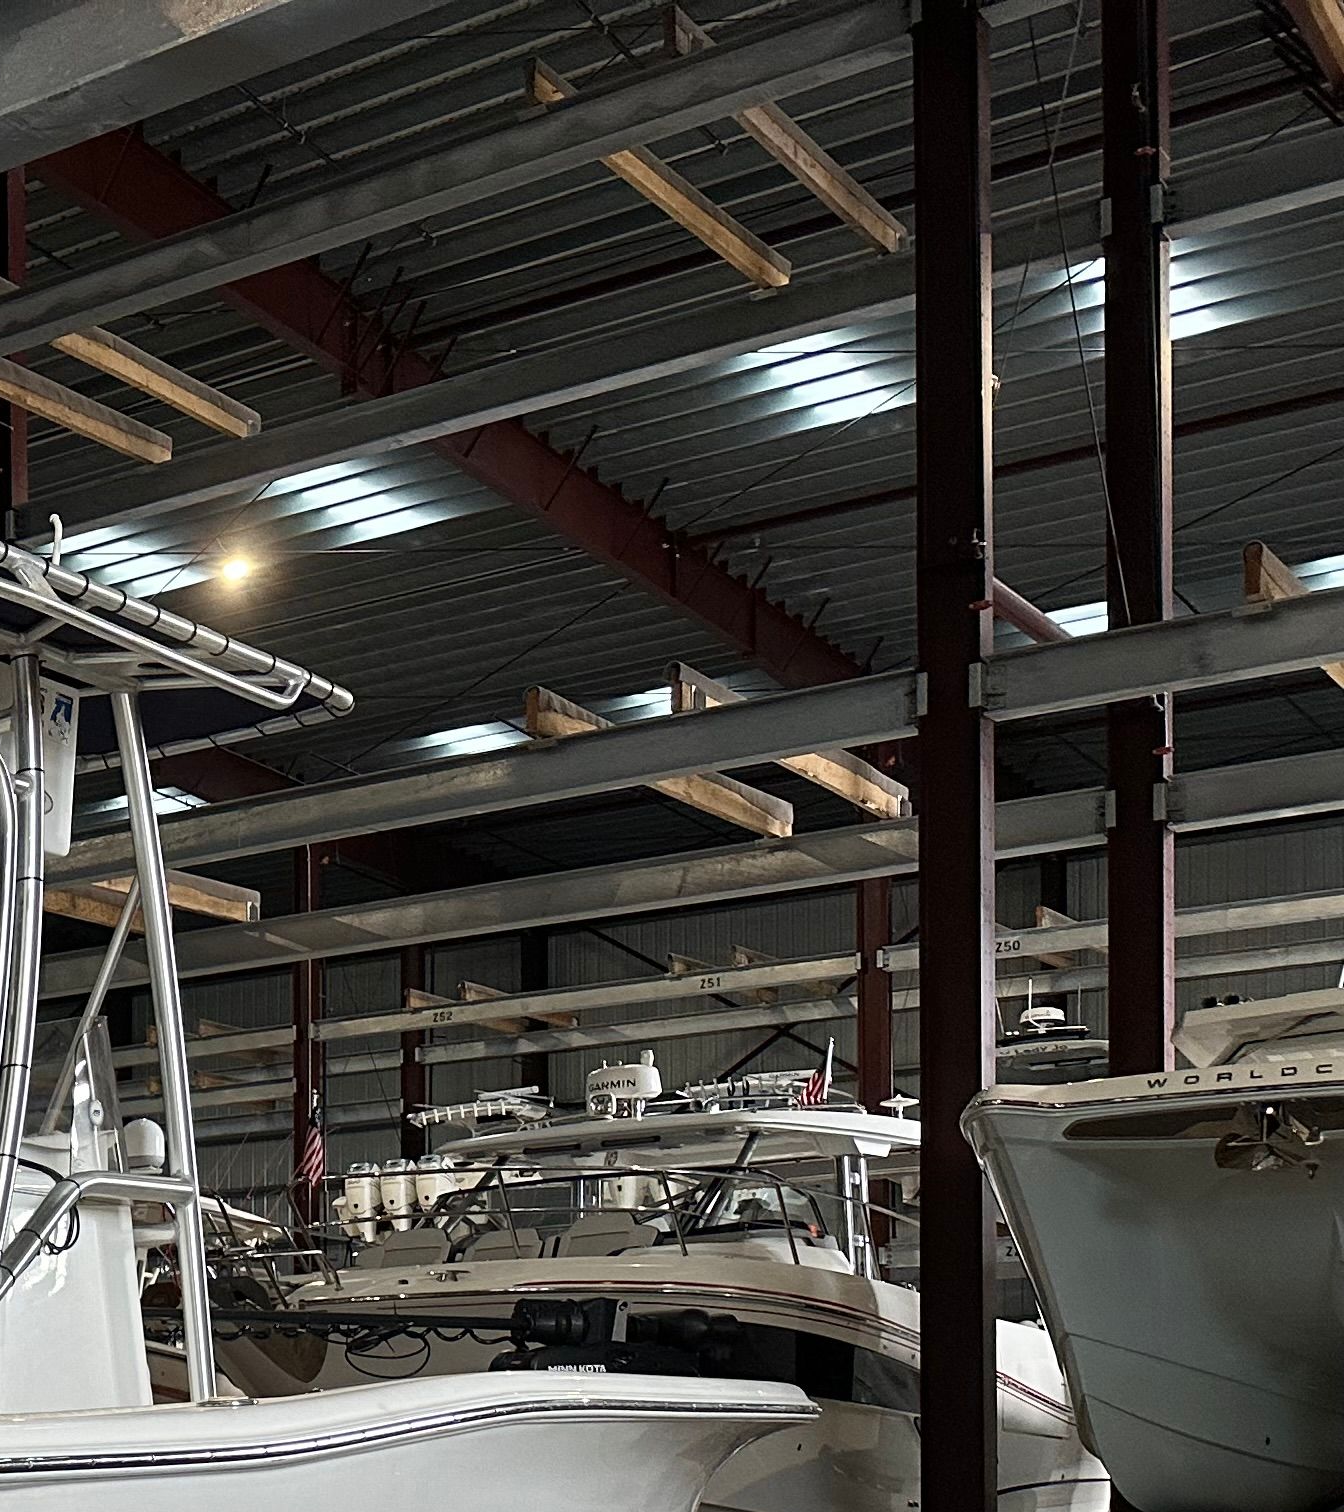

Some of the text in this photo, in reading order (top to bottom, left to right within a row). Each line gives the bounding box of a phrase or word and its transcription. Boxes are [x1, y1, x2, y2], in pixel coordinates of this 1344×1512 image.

[995, 941, 1021, 953] Z50
[700, 976, 721, 989] Z51
[432, 1011, 453, 1023] Z52
[588, 1079, 636, 1092] GARMIN
[547, 1364, 607, 1373] MINN KOTA
